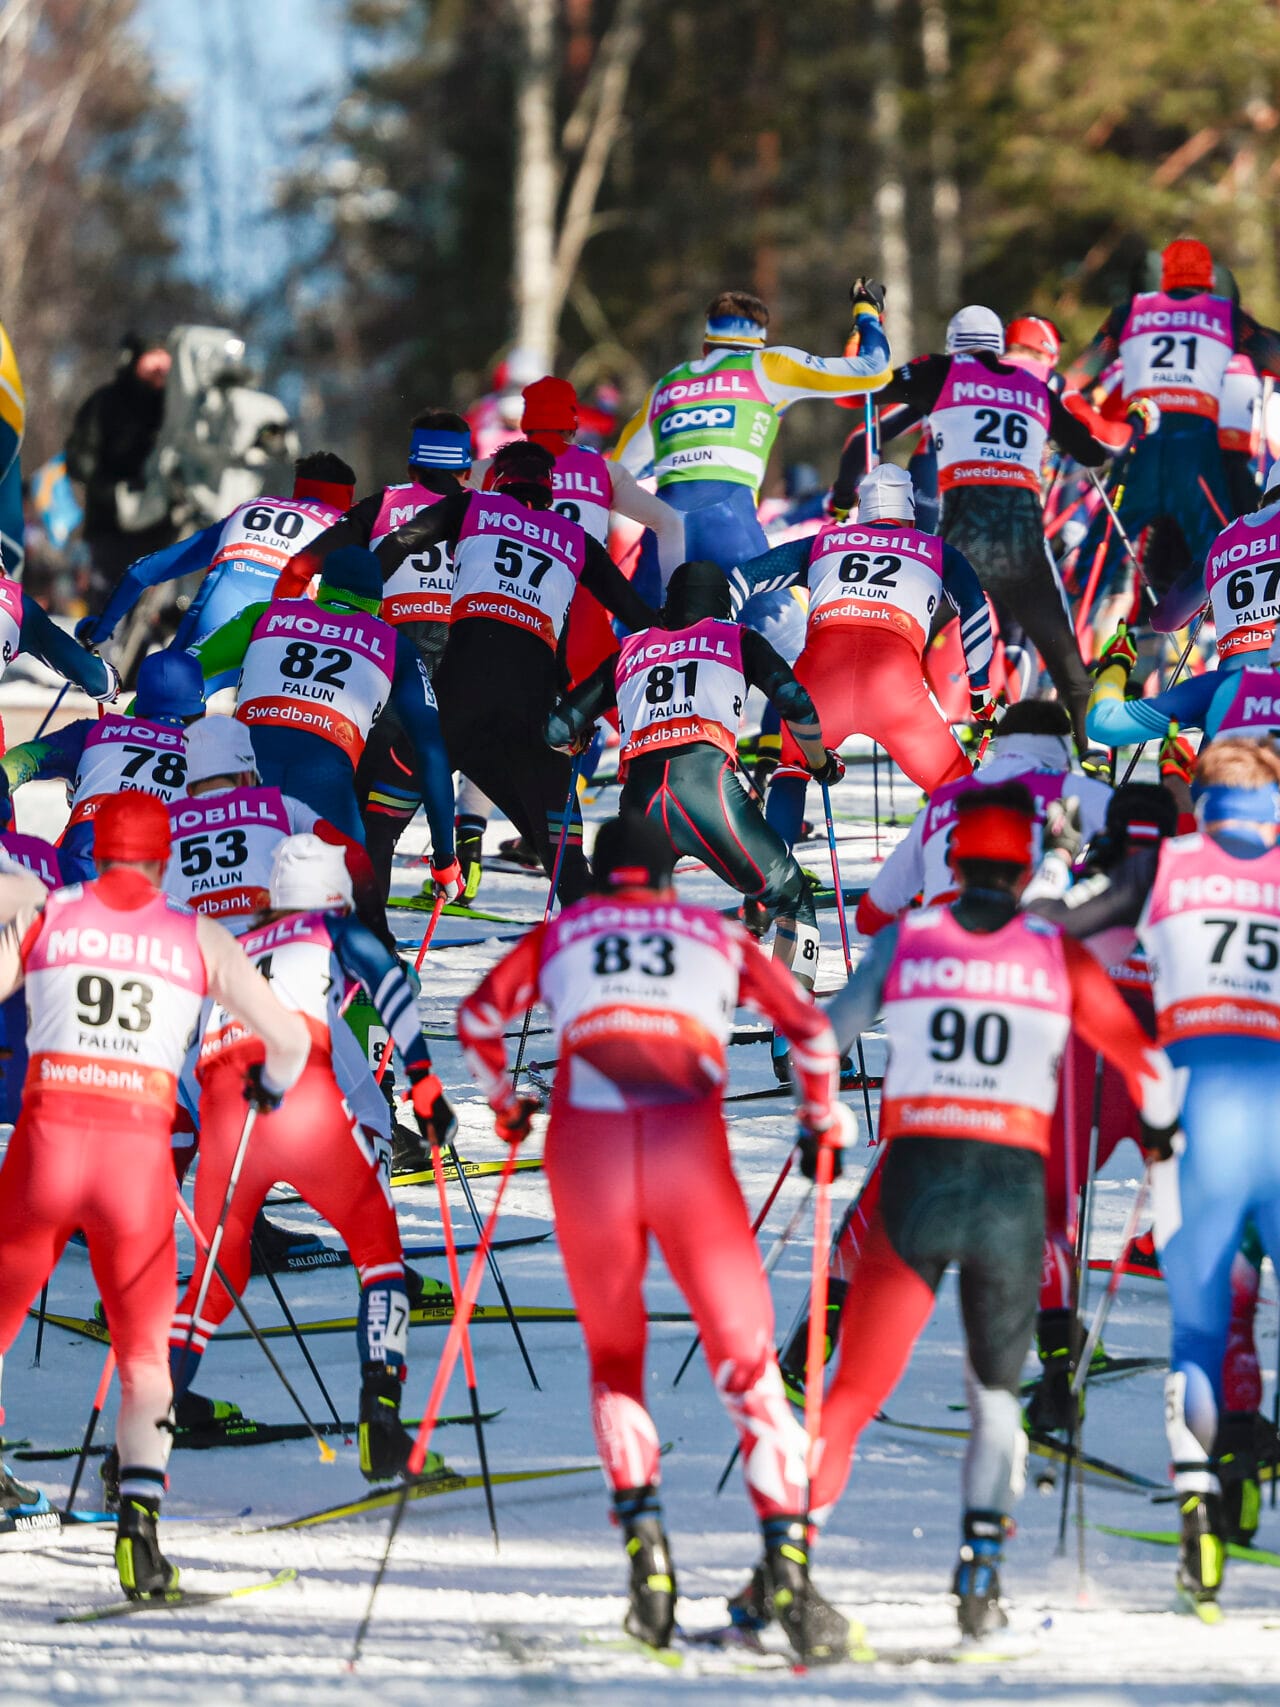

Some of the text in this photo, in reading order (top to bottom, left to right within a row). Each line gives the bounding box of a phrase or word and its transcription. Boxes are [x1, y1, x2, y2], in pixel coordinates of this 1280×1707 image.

[1132, 311, 1226, 336] MOBILL
[1151, 334, 1197, 370] 21
[1152, 371, 1193, 384] FALUN
[655, 376, 749, 414] MOBILL
[952, 381, 1047, 418] MOBILL
[749, 411, 772, 448] U23
[974, 408, 1029, 449] 26
[672, 450, 712, 466] FALUN
[980, 447, 1022, 461] FALUN
[552, 472, 604, 497] BILL
[953, 467, 1026, 481] Swedbank
[243, 507, 304, 539] 60
[478, 510, 577, 564] MOBILL
[245, 532, 290, 550] FALUN
[822, 532, 932, 559] MOBILL
[494, 539, 553, 588] 57
[838, 552, 902, 588] 62
[420, 577, 454, 591] FALU
[498, 580, 541, 605] FALUN
[841, 586, 888, 600] FALUN
[392, 601, 451, 616] Swedba
[467, 600, 542, 631] Swedbank
[813, 604, 890, 625] Swedbank
[266, 614, 386, 660] MOBILL
[280, 641, 352, 690] 82
[626, 636, 731, 673] MOBILL
[282, 682, 334, 702] FALUN
[645, 661, 698, 704] 81
[246, 706, 333, 732] Swedbank
[649, 701, 692, 720] FALUN
[625, 723, 699, 752] Swedbank
[121, 745, 188, 788] 78
[179, 829, 249, 877] 53
[191, 871, 243, 892] FALUN
[197, 893, 251, 915] dbank
[244, 918, 312, 952] BILL
[1203, 919, 1280, 972] 75
[47, 928, 191, 980] MOBILL
[594, 933, 675, 978] 83
[900, 957, 1058, 999] MOBILL
[77, 974, 153, 1032] 93
[1172, 1005, 1280, 1030] Swedbank
[79, 1033, 139, 1053] FALUN
[930, 1007, 1011, 1065] 90
[41, 1060, 145, 1091] Swedbank
[900, 1103, 1005, 1131] Swedbank
[288, 1252, 341, 1269] SALOMON
[225, 1425, 257, 1437] FISCHER
[15, 1513, 62, 1532] SALOMON
